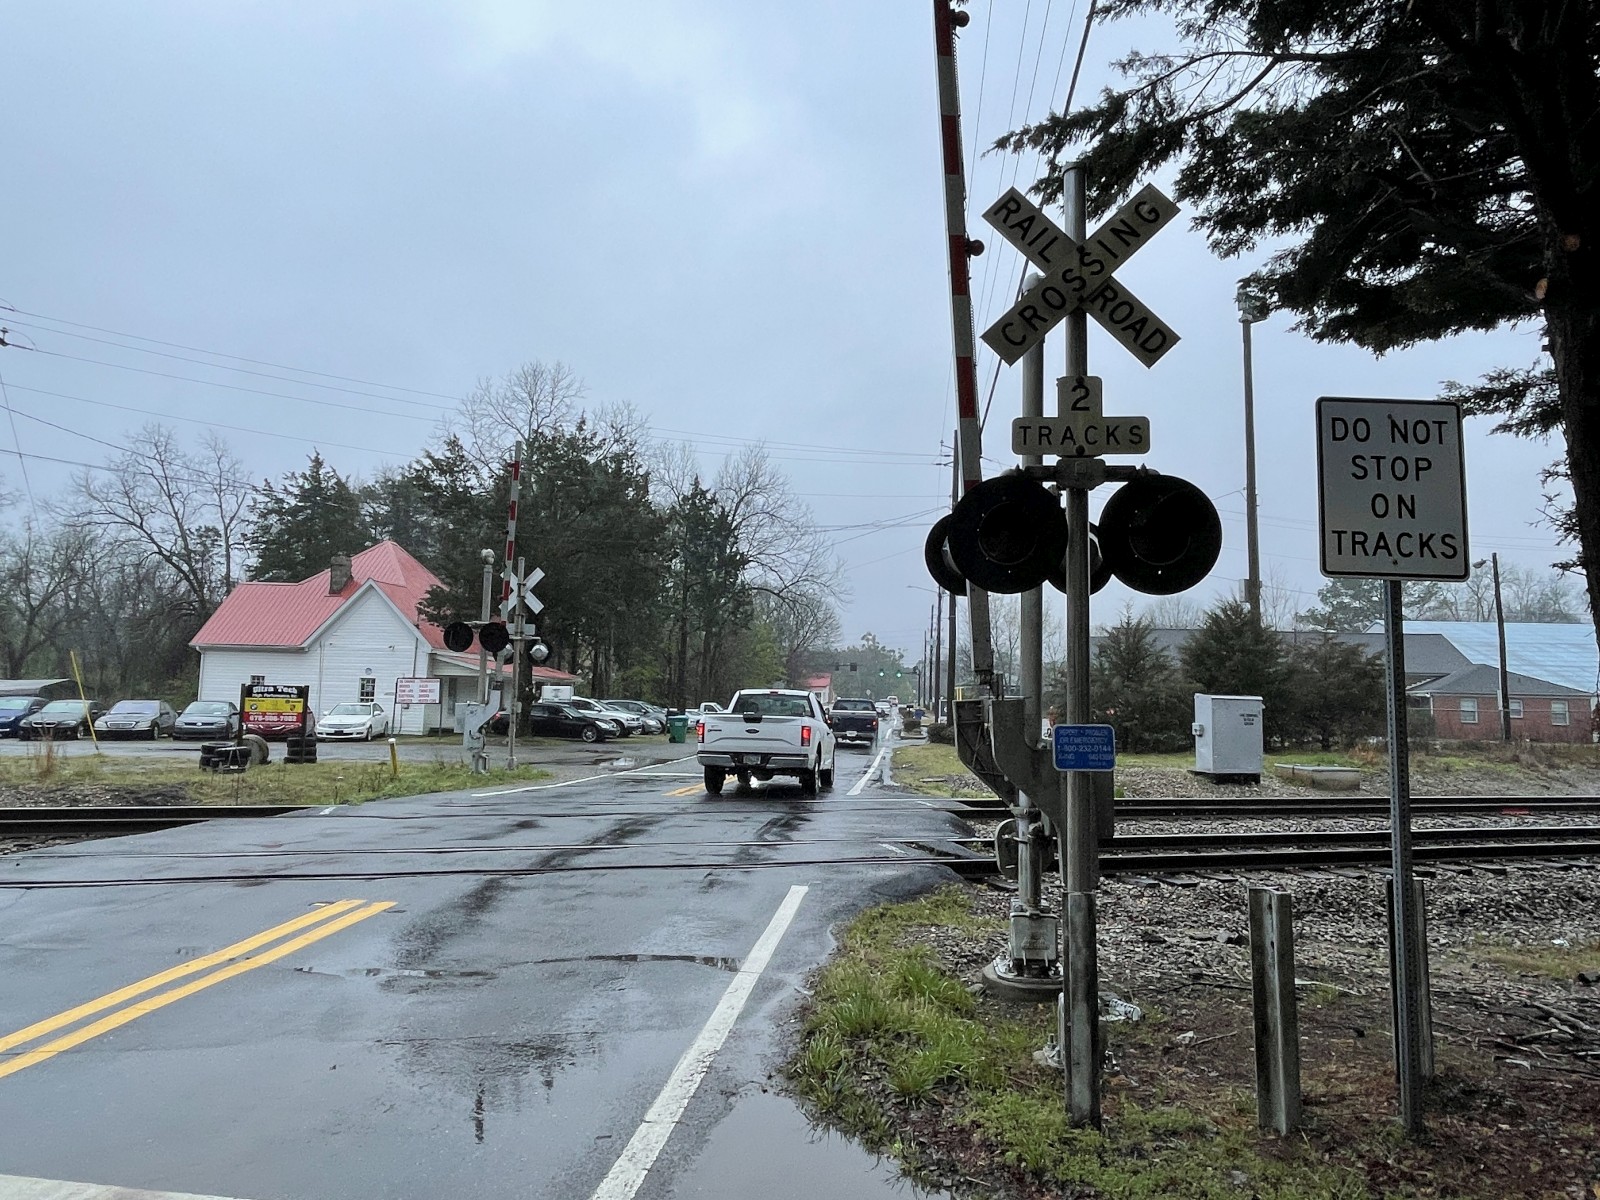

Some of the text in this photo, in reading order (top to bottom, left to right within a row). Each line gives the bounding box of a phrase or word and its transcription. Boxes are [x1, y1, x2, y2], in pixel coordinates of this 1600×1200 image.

[993, 195, 1167, 353] RAIL ROAD
[1000, 200, 1160, 347] CROSSING
[1071, 384, 1090, 411] 2
[1018, 424, 1144, 446] TRACKS
[1330, 416, 1448, 445] DO NOT
[1351, 454, 1433, 482] STOP
[1370, 492, 1416, 520] ON
[1331, 529, 1459, 560] TRACKS
